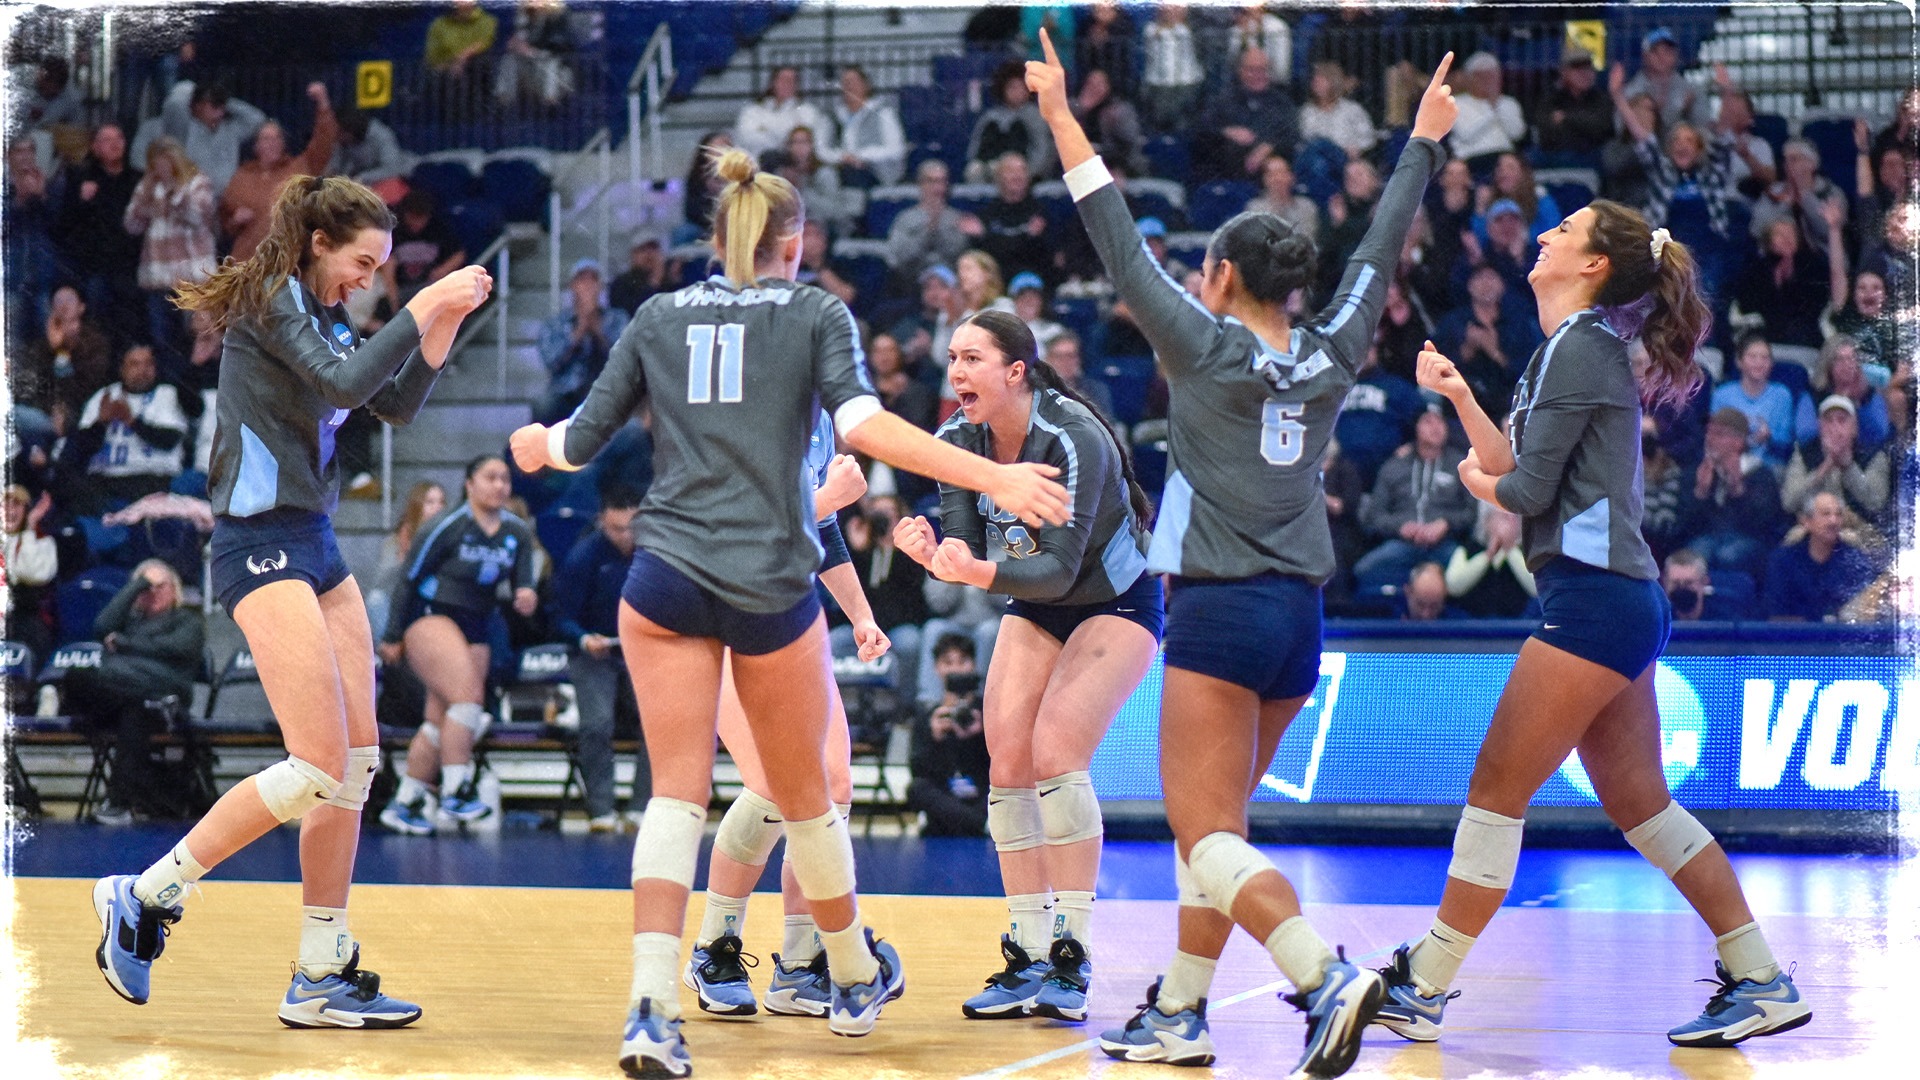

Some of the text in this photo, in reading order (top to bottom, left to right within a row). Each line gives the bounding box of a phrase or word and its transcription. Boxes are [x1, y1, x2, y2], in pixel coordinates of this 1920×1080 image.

[364, 69, 385, 99] D
[686, 322, 745, 404] 11
[1260, 397, 1307, 466] 6
